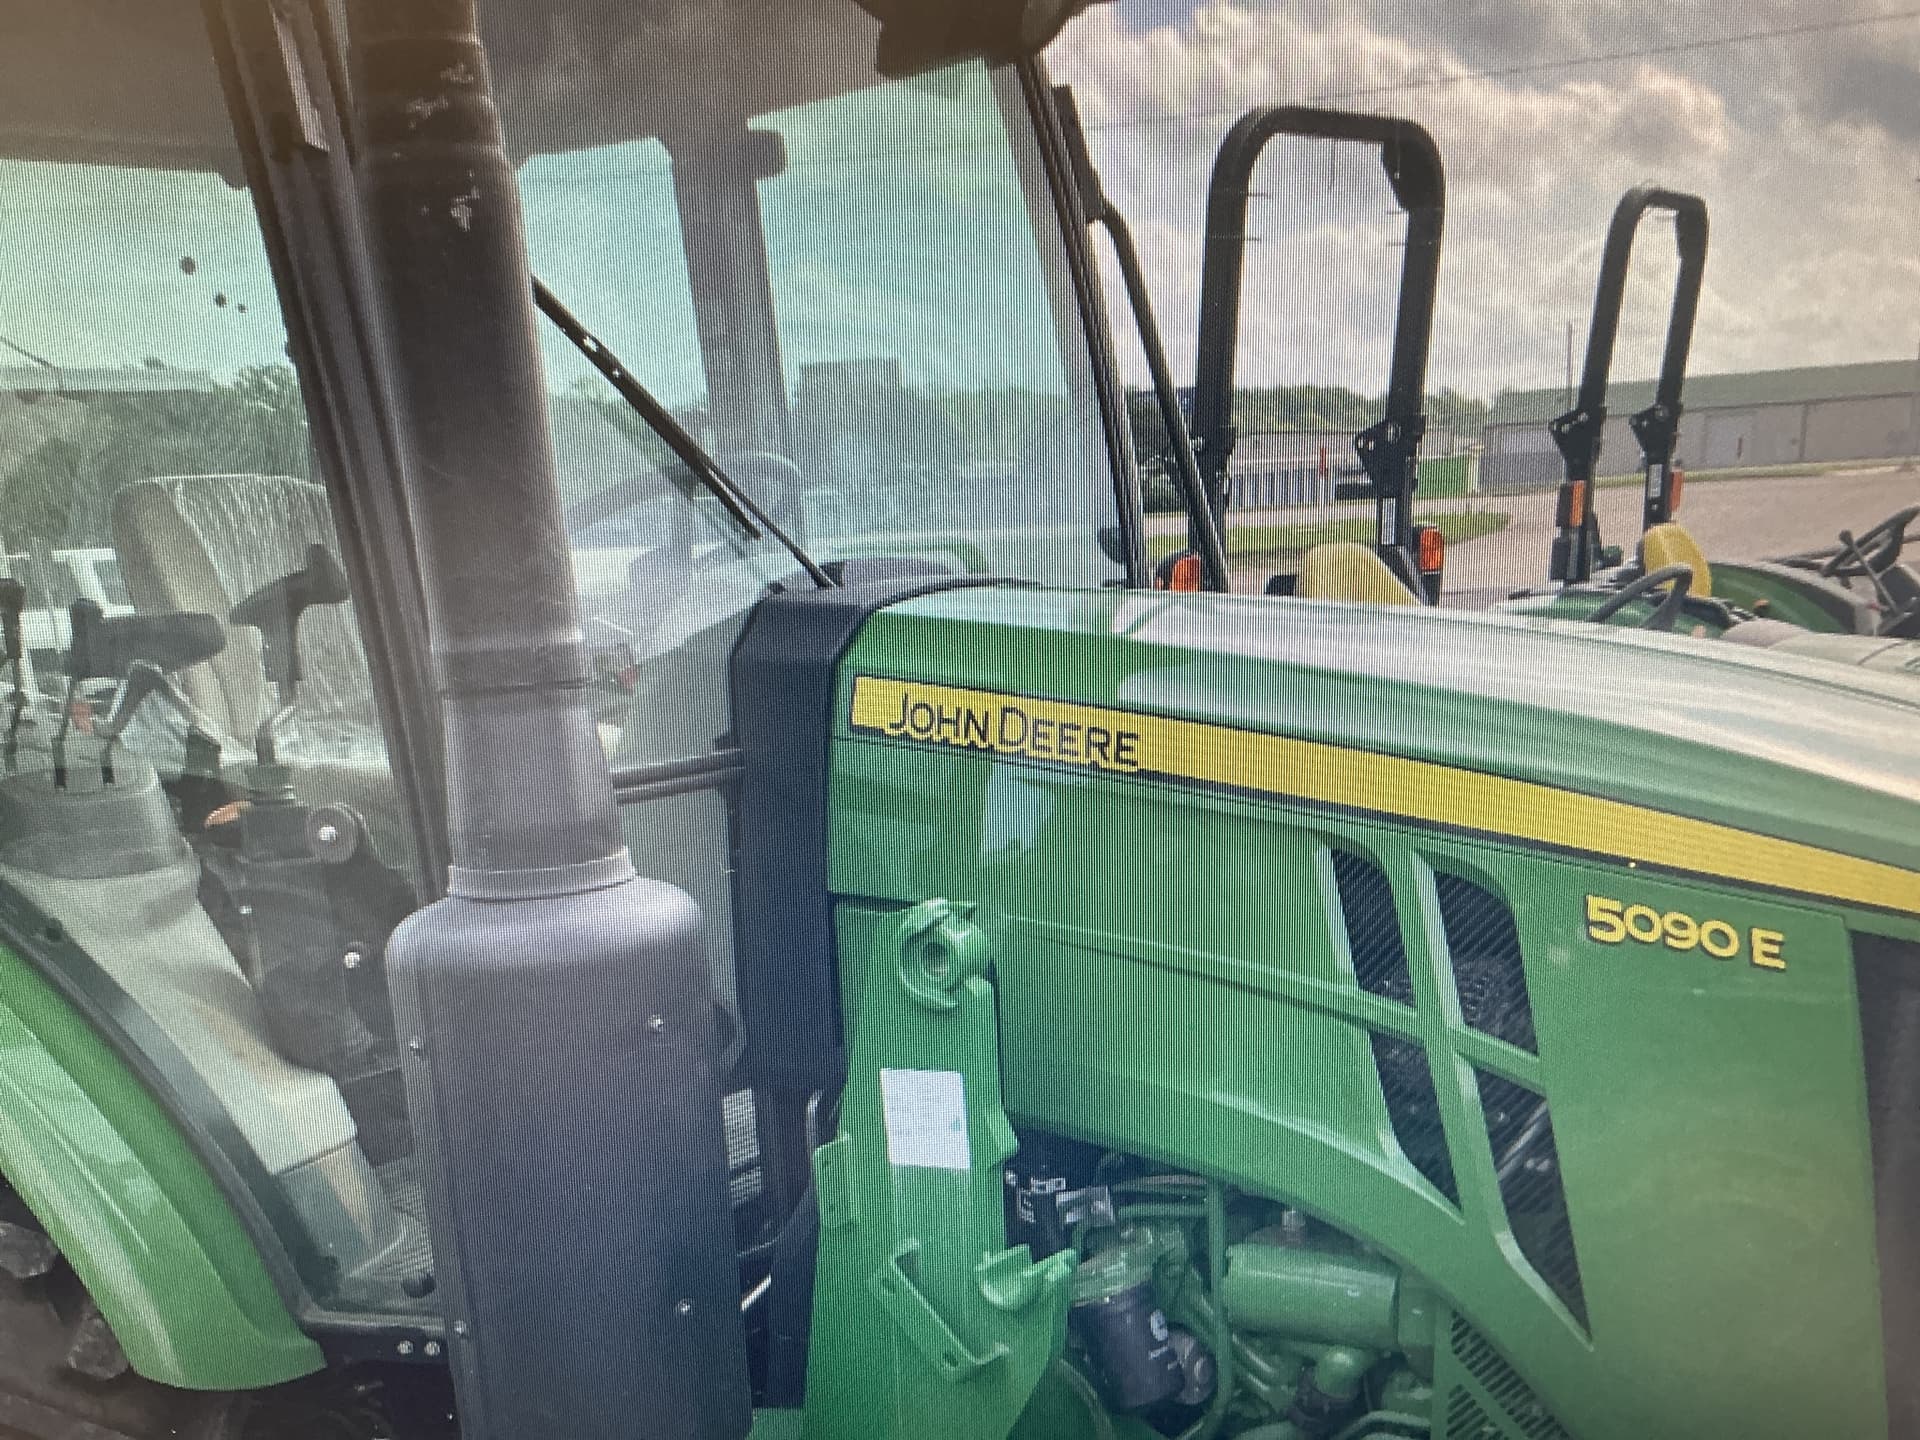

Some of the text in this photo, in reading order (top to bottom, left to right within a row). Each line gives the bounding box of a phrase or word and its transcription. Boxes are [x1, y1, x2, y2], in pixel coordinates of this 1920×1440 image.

[889, 692, 1139, 767] JOHN DEERE
[1587, 894, 1740, 958] 5090
